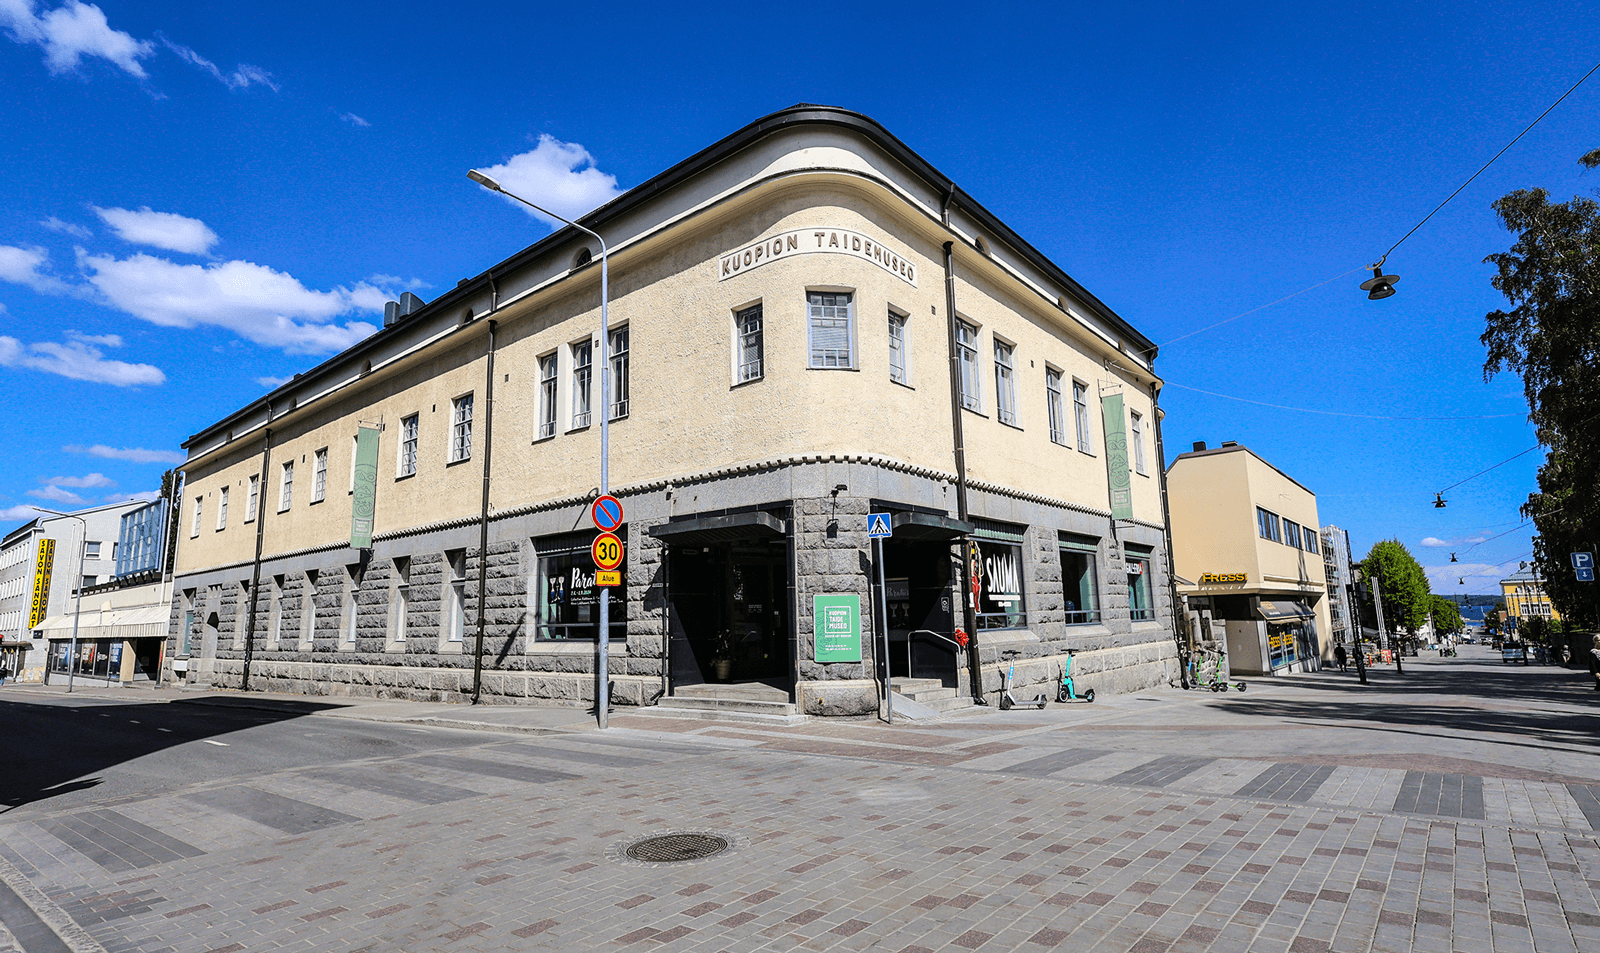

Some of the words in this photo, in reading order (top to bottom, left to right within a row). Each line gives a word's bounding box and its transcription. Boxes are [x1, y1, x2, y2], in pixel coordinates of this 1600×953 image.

[722, 234, 798, 277] KUOPION
[814, 231, 914, 281] TAIDEMUSEO
[37, 540, 46, 575] SAVON
[45, 540, 55, 575] SAVON
[598, 542, 618, 561] 30
[1575, 554, 1589, 567] P
[602, 574, 615, 582] Alue
[986, 553, 1020, 593] SAUMA
[1202, 572, 1248, 583] FRESSI
[30, 578, 41, 628] SANOMAT
[39, 578, 49, 622] SANOMA
